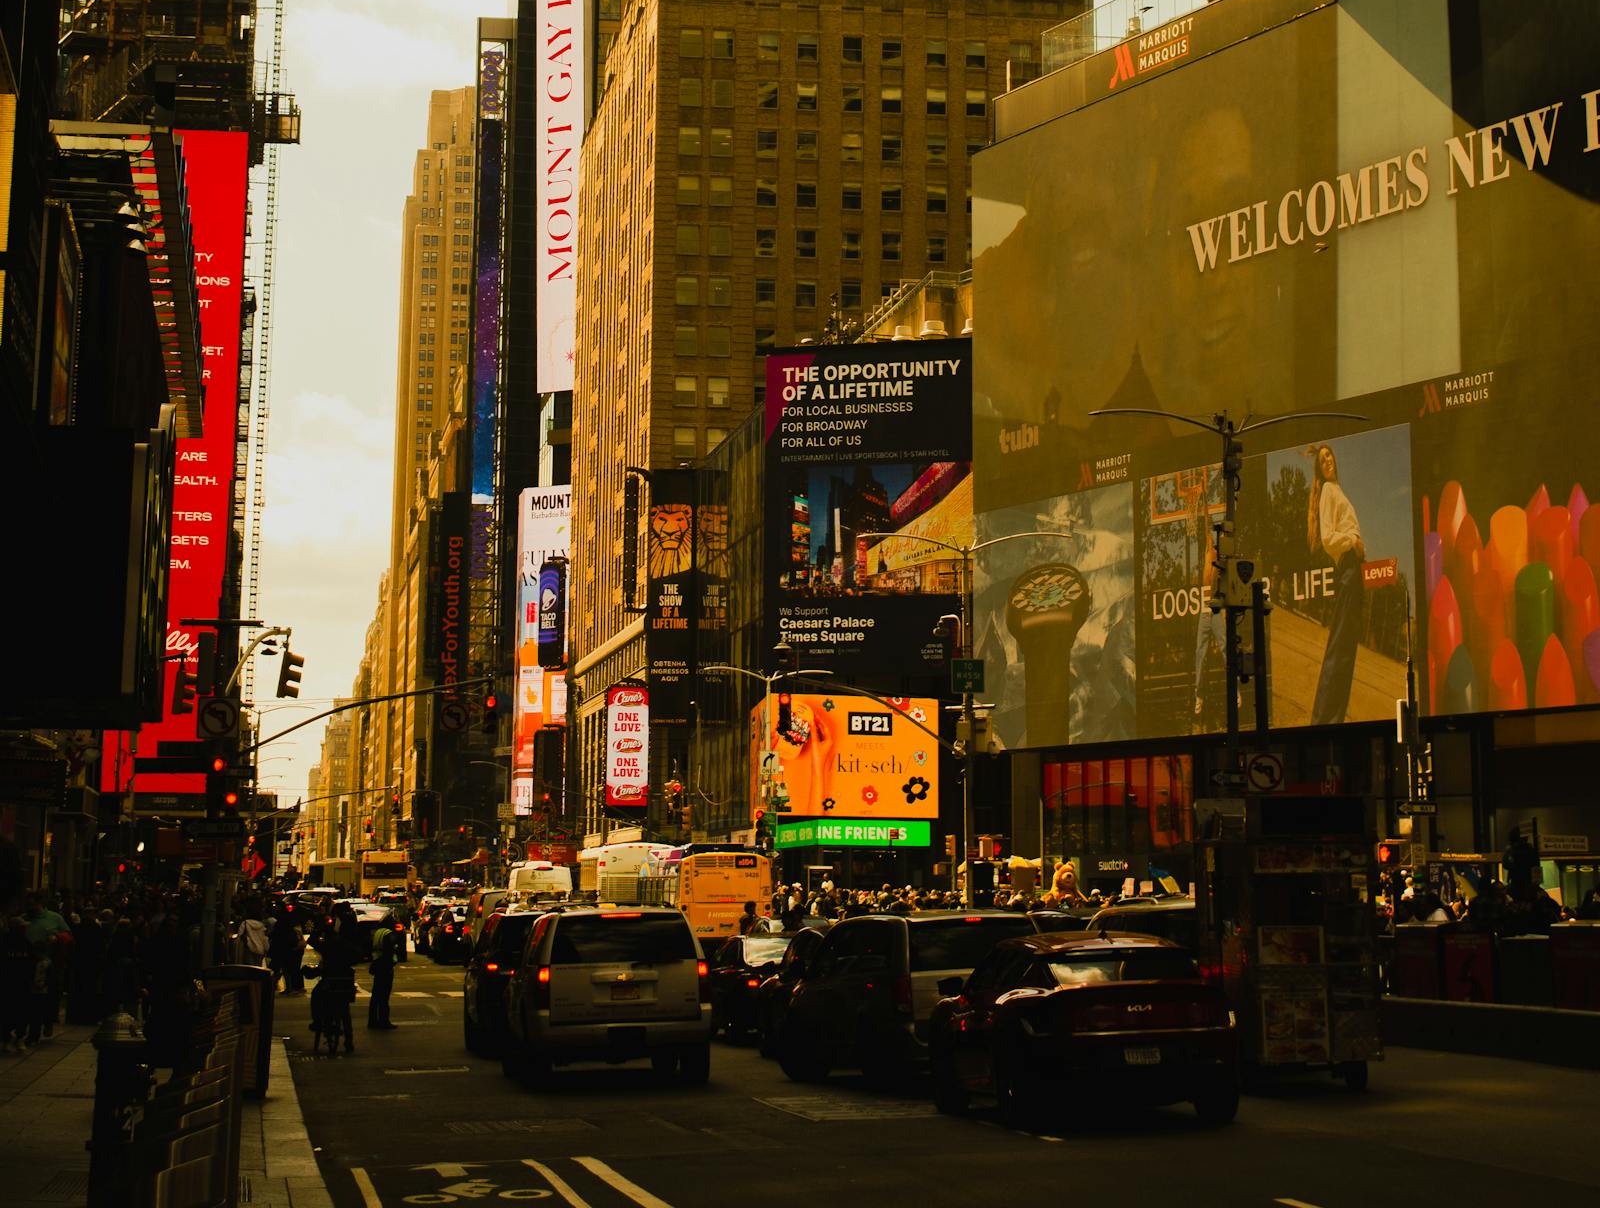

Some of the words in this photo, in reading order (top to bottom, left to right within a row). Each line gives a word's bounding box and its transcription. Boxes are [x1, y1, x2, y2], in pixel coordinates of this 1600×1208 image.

[1139, 17, 1194, 52] MARRIOTT
[1139, 39, 1187, 70] MARQUIS
[547, 23, 573, 103] GAY
[1186, 145, 1430, 273] WELCOMES
[1444, 101, 1563, 195] NEW
[547, 117, 573, 282] MOUNT
[195, 253, 214, 262] TY
[196, 276, 231, 286] IONS
[782, 366, 820, 383] THE
[824, 359, 961, 382] OPPORTUNITY
[1444, 371, 1495, 392] MARRIOTT
[782, 385, 807, 402] OF
[811, 384, 825, 400] A
[829, 380, 914, 399] LIFETIME
[1445, 387, 1489, 407] MARQUIS
[782, 406, 803, 417] FOR
[806, 405, 842, 416] LOCAL
[846, 402, 913, 414] BUSINESSES
[781, 422, 803, 433] FOR
[806, 419, 868, 432] BROADWAY
[781, 438, 803, 448] FOR
[806, 437, 826, 448] ALL
[828, 436, 844, 447] OF
[846, 435, 862, 445] US
[999, 423, 1039, 454] tubi
[180, 452, 208, 462] ARE
[781, 454, 834, 463] ENTERTAINMENT
[854, 452, 898, 460] SPORTSBOOK
[1096, 454, 1131, 469] MARRIOTT
[174, 475, 218, 486] EALTH.
[1096, 468, 1128, 482] MARQUIS
[531, 494, 571, 511] MOUNT
[171, 535, 209, 545] GETS
[170, 559, 191, 569] EM.
[663, 583, 679, 595] THE
[1293, 567, 1335, 601] LIFE
[659, 595, 683, 607] SHOW
[1152, 585, 1212, 620] LOOSE
[540, 612, 557, 621] TACO
[661, 607, 673, 617] OF
[673, 607, 679, 617] A
[779, 607, 793, 616] We
[794, 606, 829, 617] Support
[541, 620, 556, 629] BELL
[652, 618, 688, 630] LIFETIME
[779, 617, 831, 629] Caesars
[833, 616, 875, 628] Palace
[780, 631, 818, 643] Times
[820, 630, 865, 644] Square
[617, 712, 639, 722] ONE
[851, 715, 890, 732] BT21
[614, 723, 641, 732] LOVE
[856, 742, 885, 750] MEETS
[616, 757, 638, 767] ONE
[613, 768, 640, 778] LOVE
[816, 826, 842, 839] INE
[1098, 860, 1124, 871] swatch
[1127, 1003, 1152, 1012] KIA
